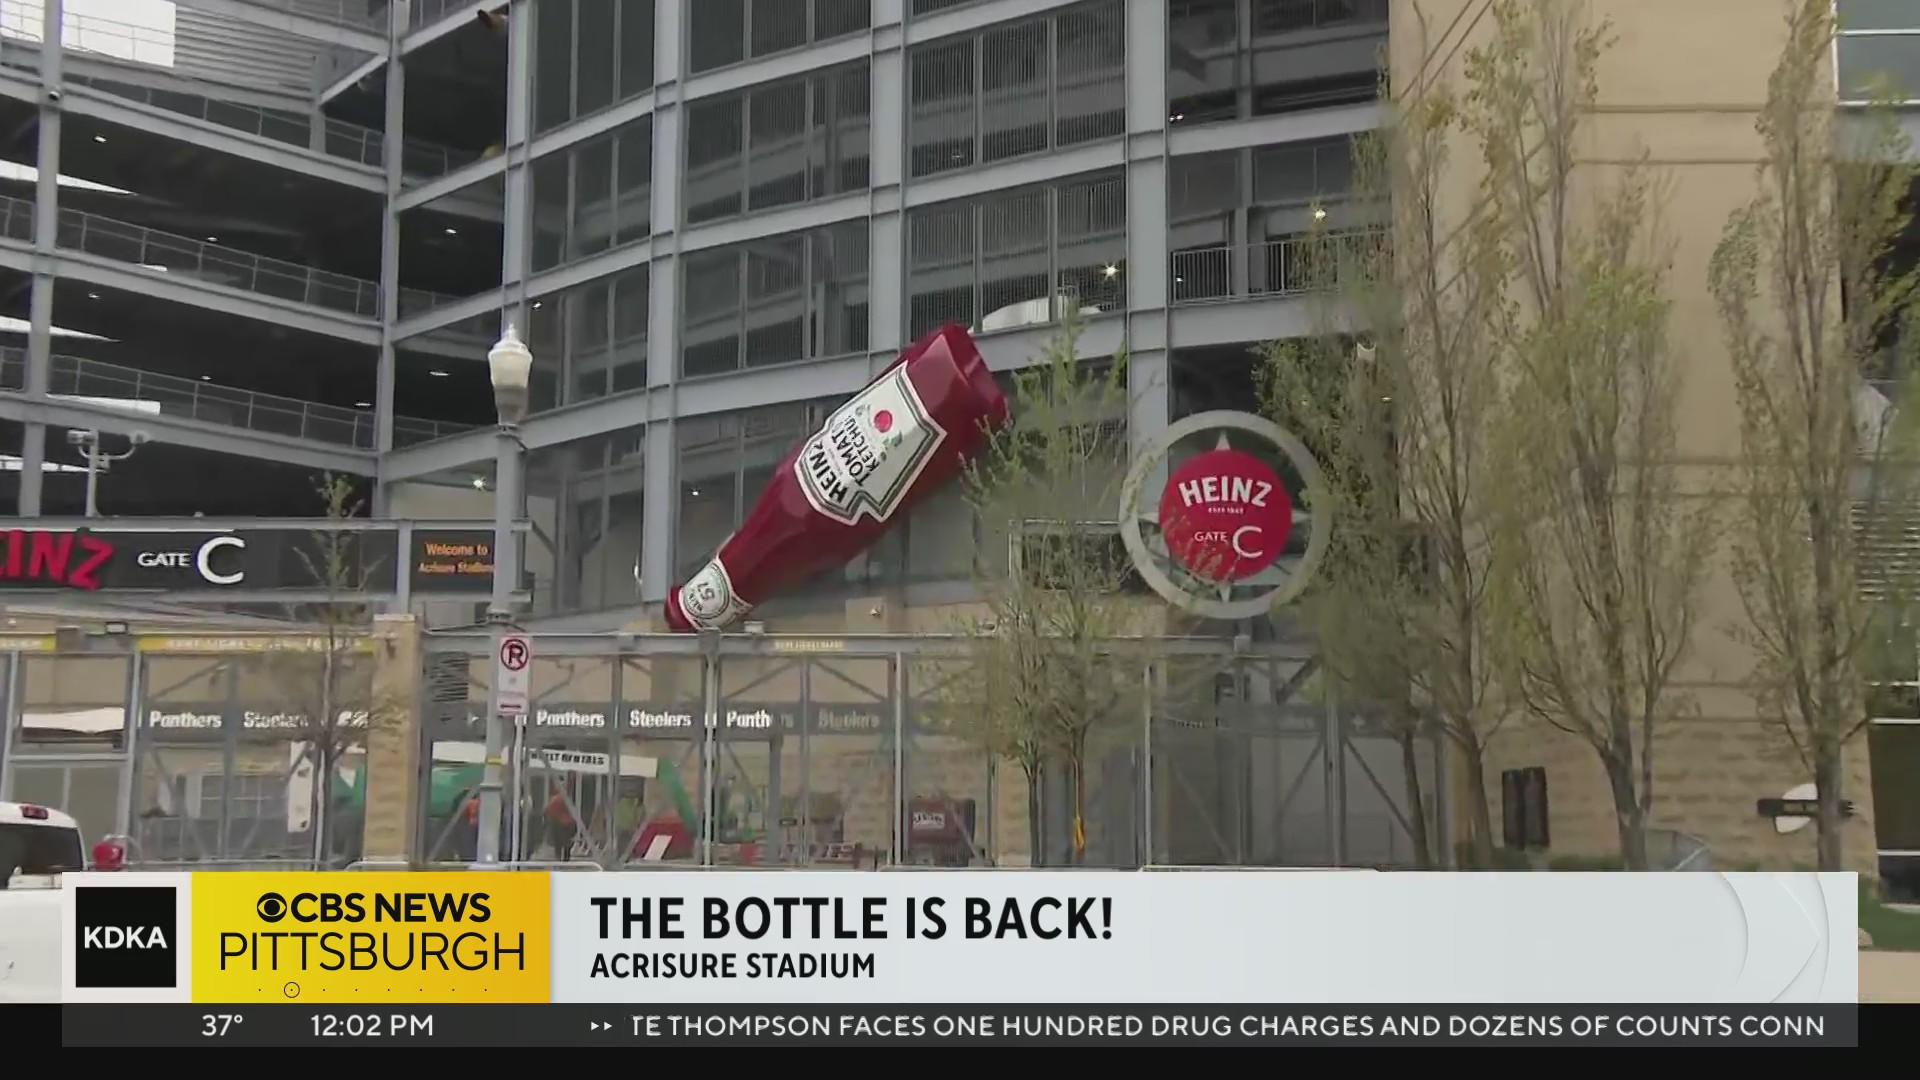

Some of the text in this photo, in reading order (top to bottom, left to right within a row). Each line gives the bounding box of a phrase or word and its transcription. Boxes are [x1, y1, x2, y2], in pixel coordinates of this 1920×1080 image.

[1178, 475, 1272, 507] HEINZ
[425, 543, 489, 556] Welcome to
[1194, 525, 1263, 558] GATE C
[137, 536, 245, 584] GATE C
[149, 710, 223, 729] Panthers
[536, 709, 692, 728] Panthers Steelers
